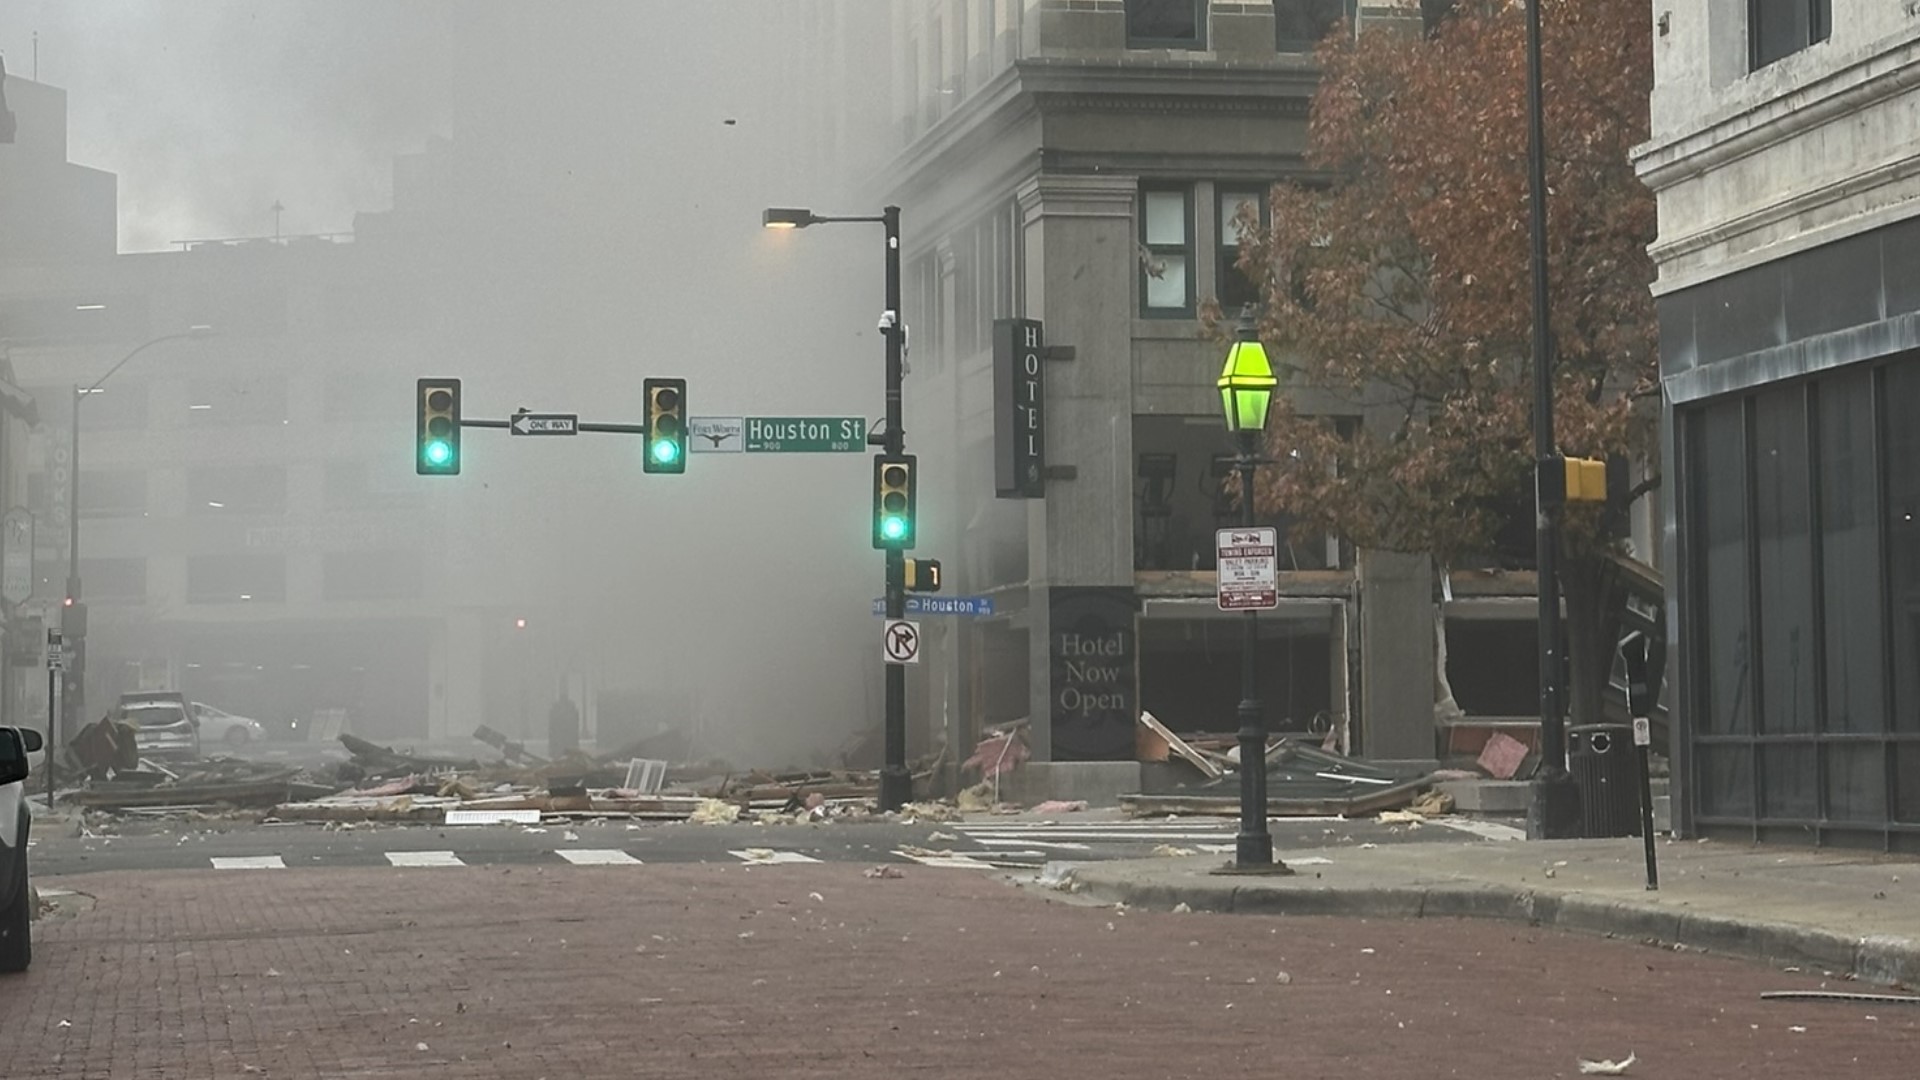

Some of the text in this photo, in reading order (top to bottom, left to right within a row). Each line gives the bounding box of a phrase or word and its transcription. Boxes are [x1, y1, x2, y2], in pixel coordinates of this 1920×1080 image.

[1025, 326, 1038, 456] HOTEL
[530, 421, 570, 429] ONE WAY
[750, 419, 861, 440] Houston St
[763, 442, 780, 450] 900
[832, 442, 849, 450] 800
[930, 566, 938, 585] 1
[922, 598, 974, 613] Houston
[1061, 632, 1124, 656] Hotel
[1065, 660, 1120, 682] Now
[1060, 687, 1125, 717] Open
